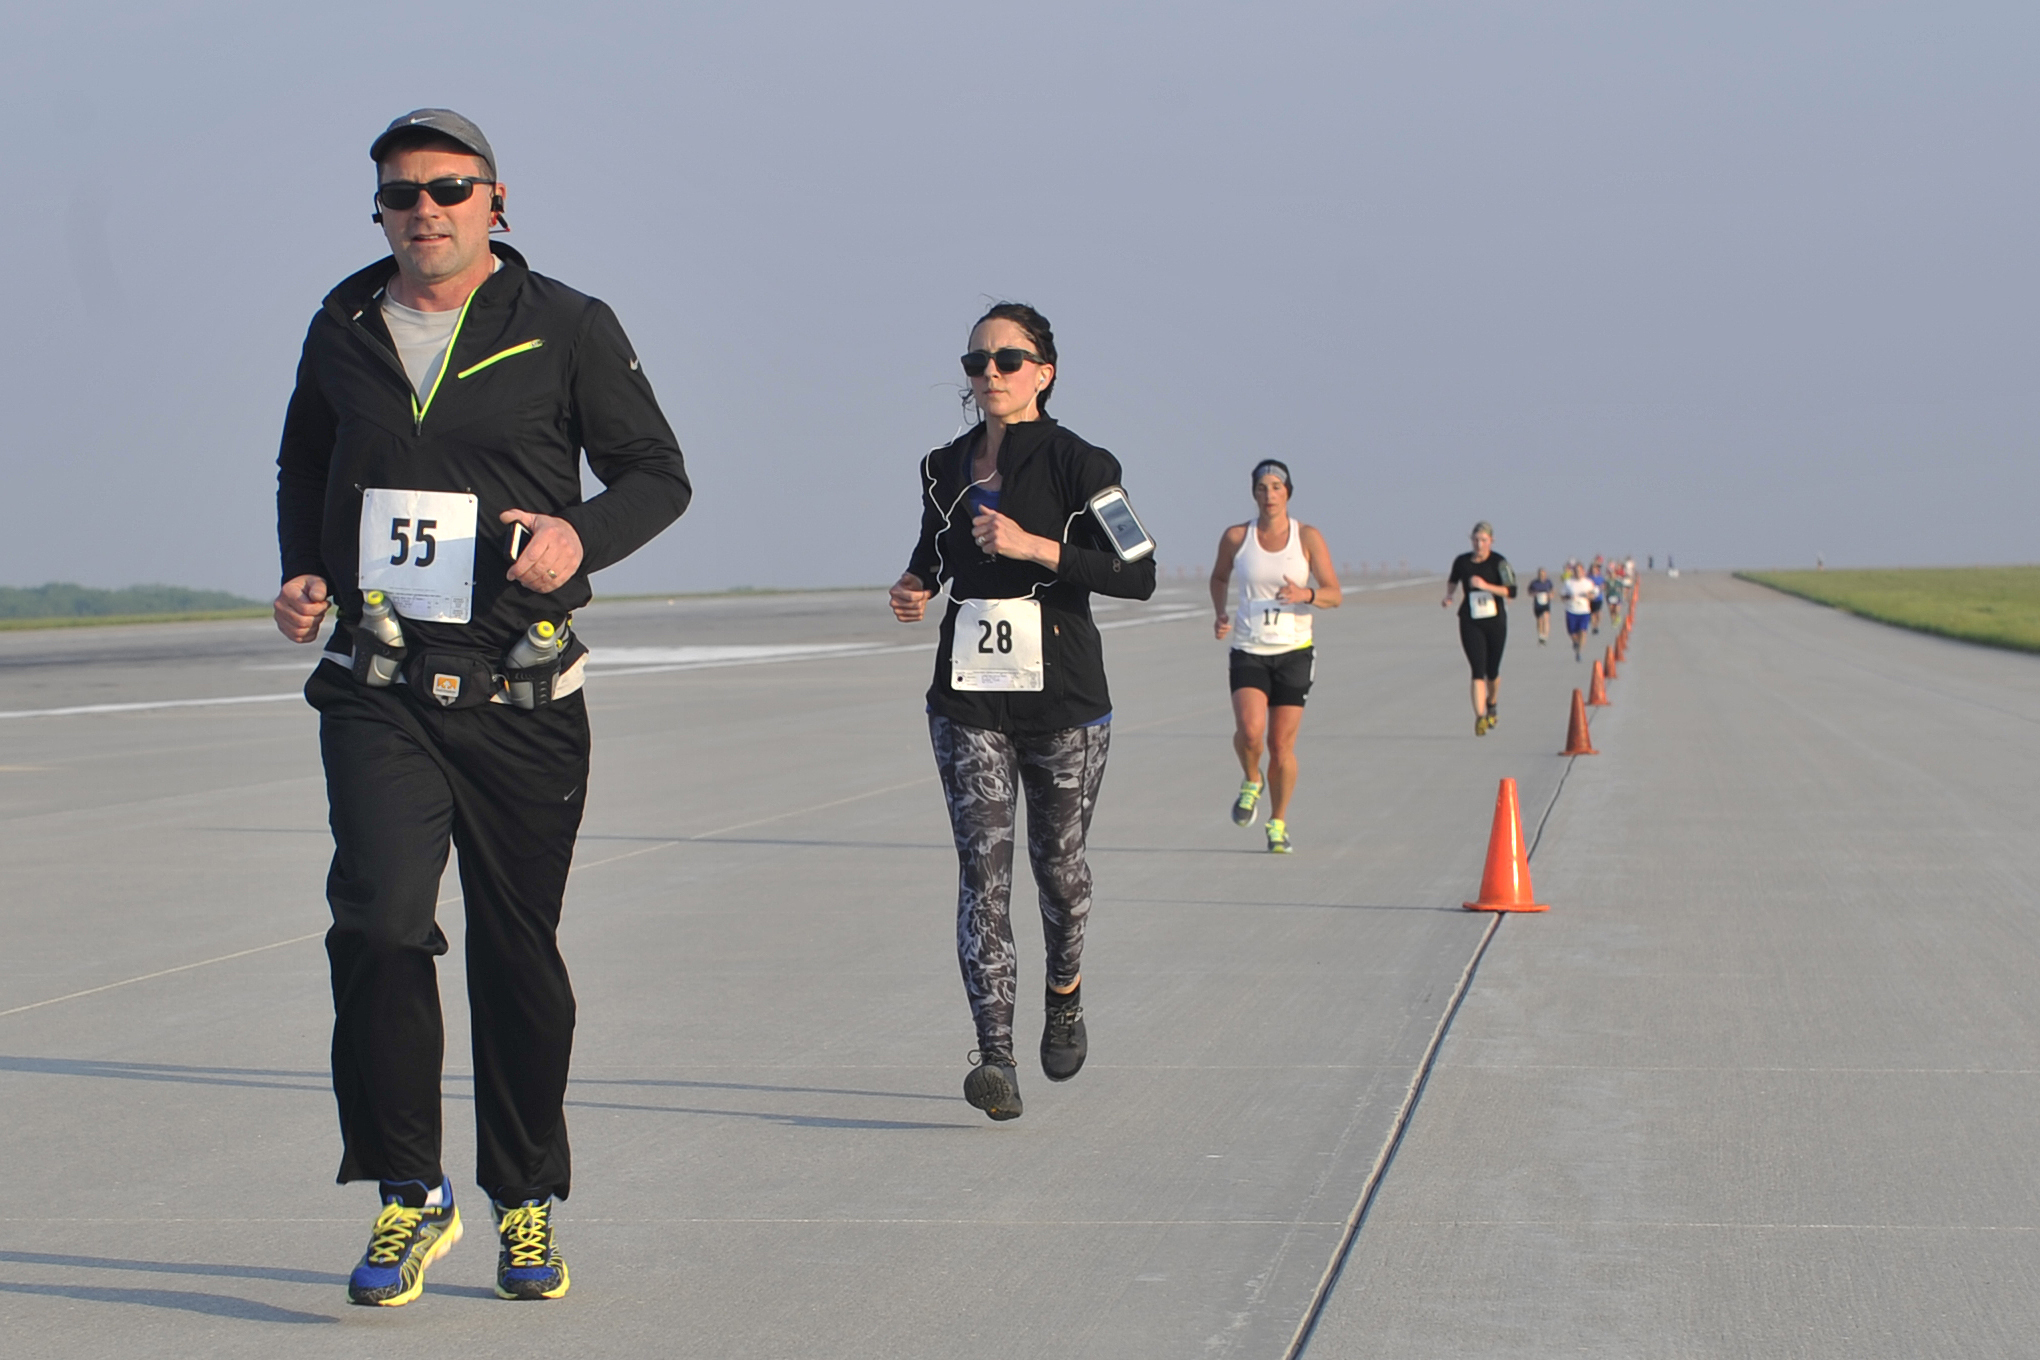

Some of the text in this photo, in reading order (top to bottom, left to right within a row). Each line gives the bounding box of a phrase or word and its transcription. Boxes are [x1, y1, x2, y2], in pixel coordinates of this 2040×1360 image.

[390, 517, 437, 568] 55
[1264, 608, 1281, 626] 17
[978, 619, 1012, 654] 28
